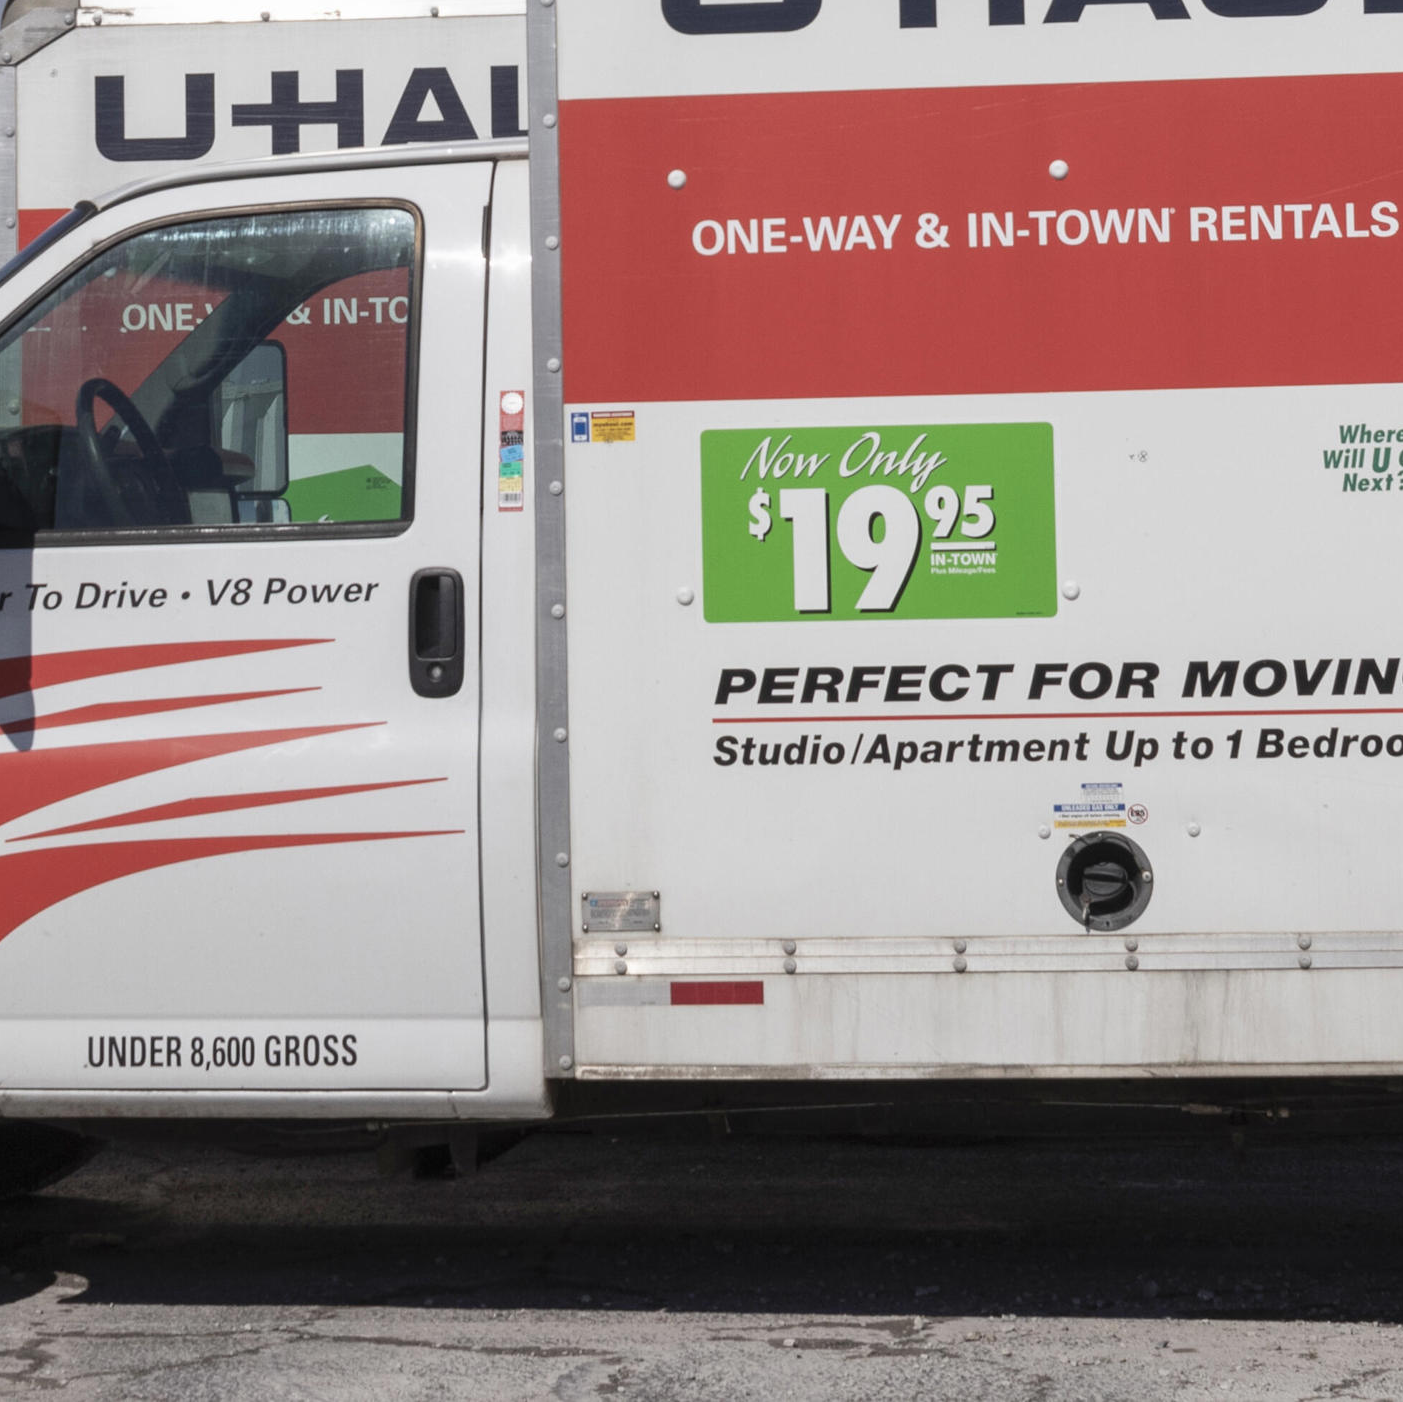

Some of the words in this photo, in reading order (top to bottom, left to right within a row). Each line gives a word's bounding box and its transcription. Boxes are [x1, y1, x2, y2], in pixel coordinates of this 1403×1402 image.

[692, 213, 902, 256] ONE-WAY
[916, 213, 950, 249] &
[1190, 201, 1400, 243] RENTALS
[740, 435, 830, 481] Now
[839, 431, 947, 494] Only
[1323, 448, 1365, 469] Will
[1372, 447, 1392, 473] U
[930, 552, 997, 566] IN-TOWN
[25, 583, 63, 612] To
[75, 581, 168, 610] Drive
[206, 578, 252, 606] V8
[263, 578, 379, 606] Power
[713, 662, 1015, 705] PERFECT
[1027, 661, 1160, 701] FOR
[1104, 730, 1159, 769] Up
[1172, 728, 1214, 760] to
[1226, 728, 1243, 759] 1
[87, 1036, 182, 1068] UNDER
[190, 1035, 256, 1071] 8,600
[264, 1034, 358, 1067] GROSS
